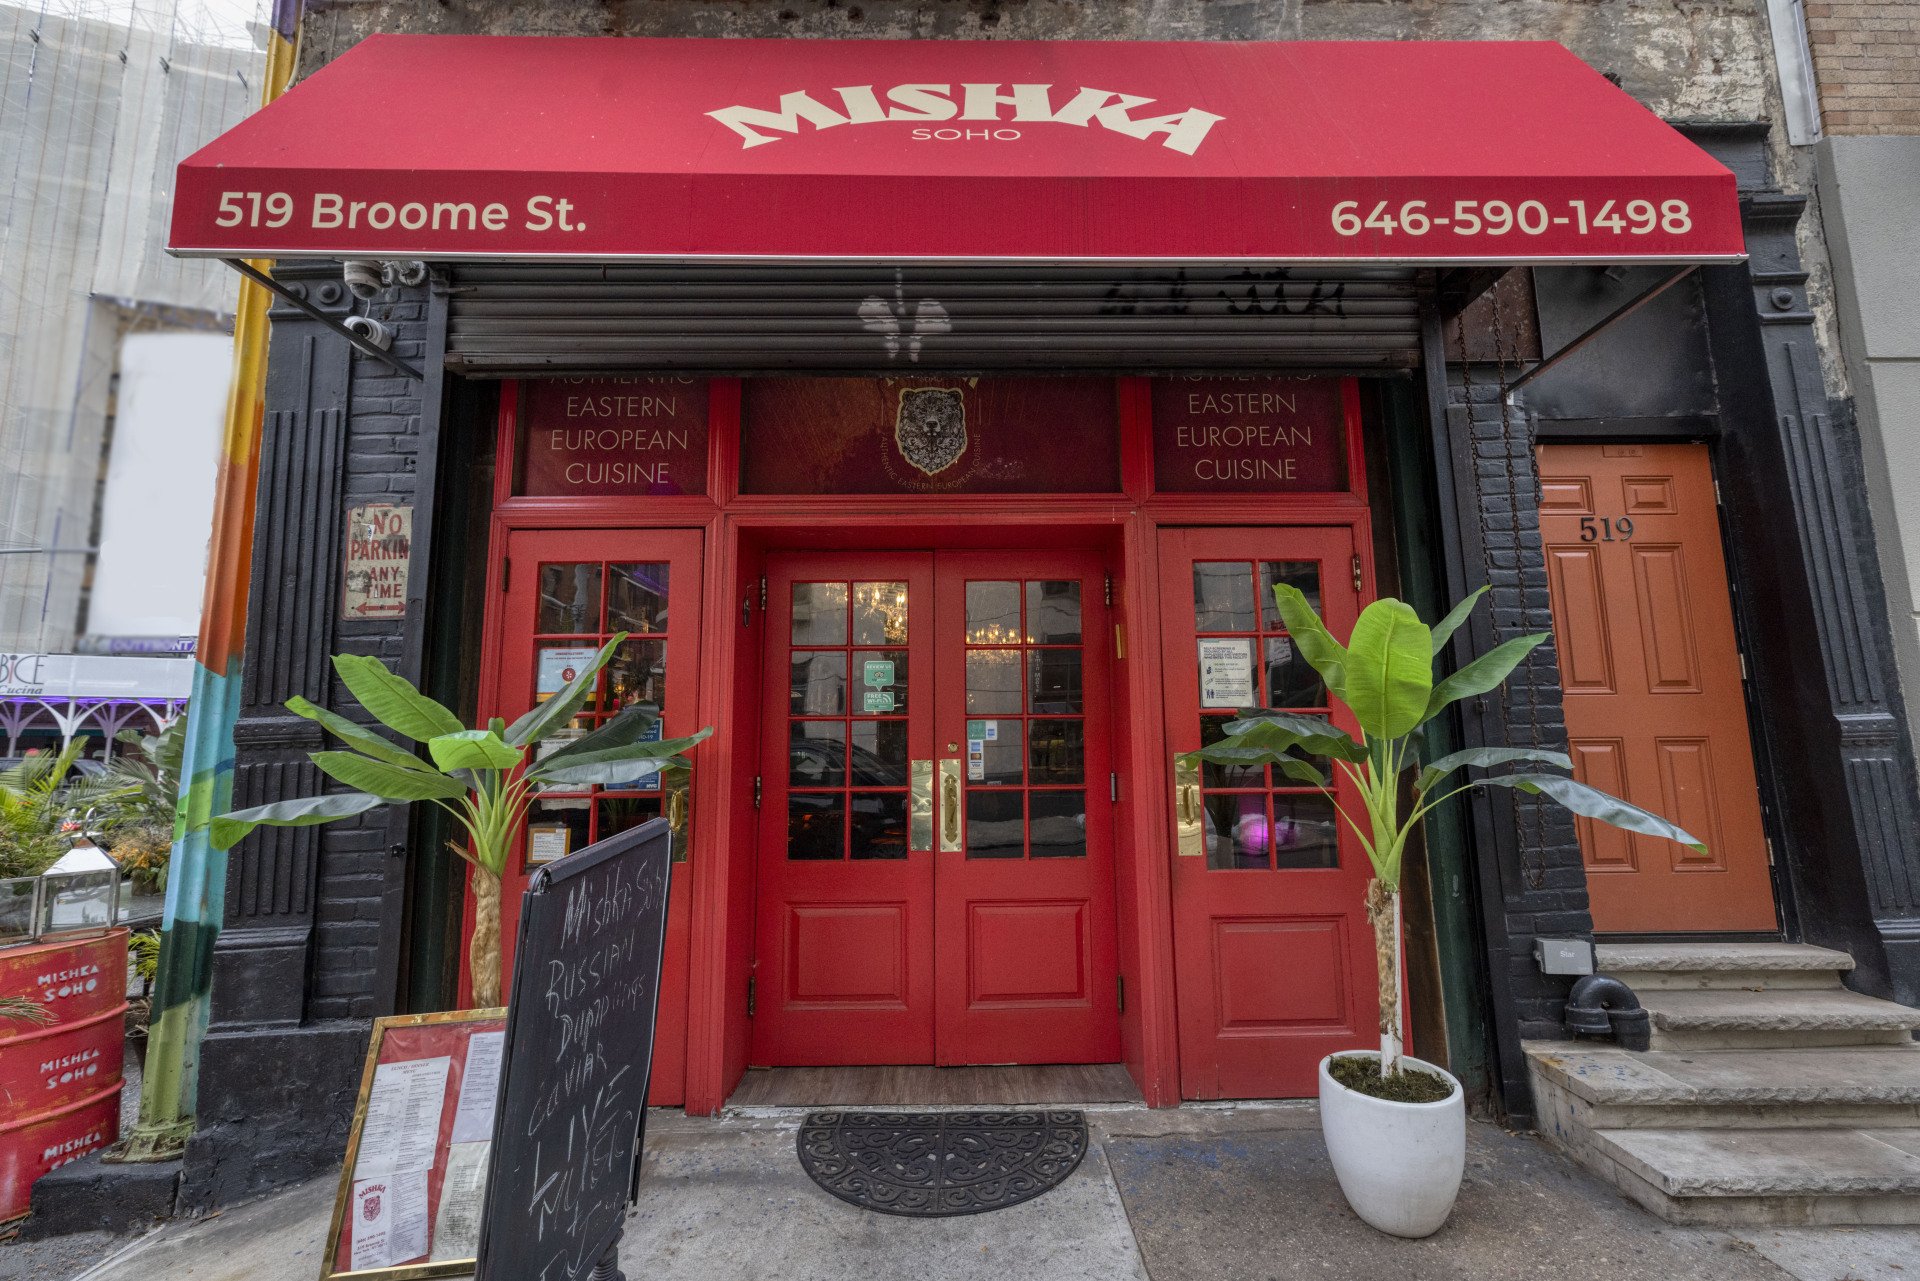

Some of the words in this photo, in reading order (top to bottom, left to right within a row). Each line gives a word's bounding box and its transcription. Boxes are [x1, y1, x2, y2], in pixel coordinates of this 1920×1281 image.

[704, 83, 1226, 156] MISHKA
[911, 128, 1022, 141] SOHO
[215, 191, 294, 229] 519
[312, 192, 509, 231] Broome
[525, 195, 587, 232] St.
[1331, 199, 1693, 236] 646-590-1498
[566, 396, 676, 417] EASTERN
[1188, 393, 1297, 414] EASTERN
[551, 429, 688, 450] EUROPEAN
[1177, 426, 1312, 447] EUROPEAN
[565, 462, 670, 484] CUISINE
[1195, 458, 1297, 480] CUISINE
[373, 513, 403, 535] NO
[1580, 515, 1634, 542] 519
[369, 566, 400, 582] ANY
[38, 964, 100, 987] MISHKA
[44, 978, 97, 1002] SOHO
[40, 1050, 101, 1073] MISHKA
[46, 1062, 98, 1090] SOHO
[44, 1131, 102, 1161] MISHKA
[358, 1183, 387, 1200] MISHKA
